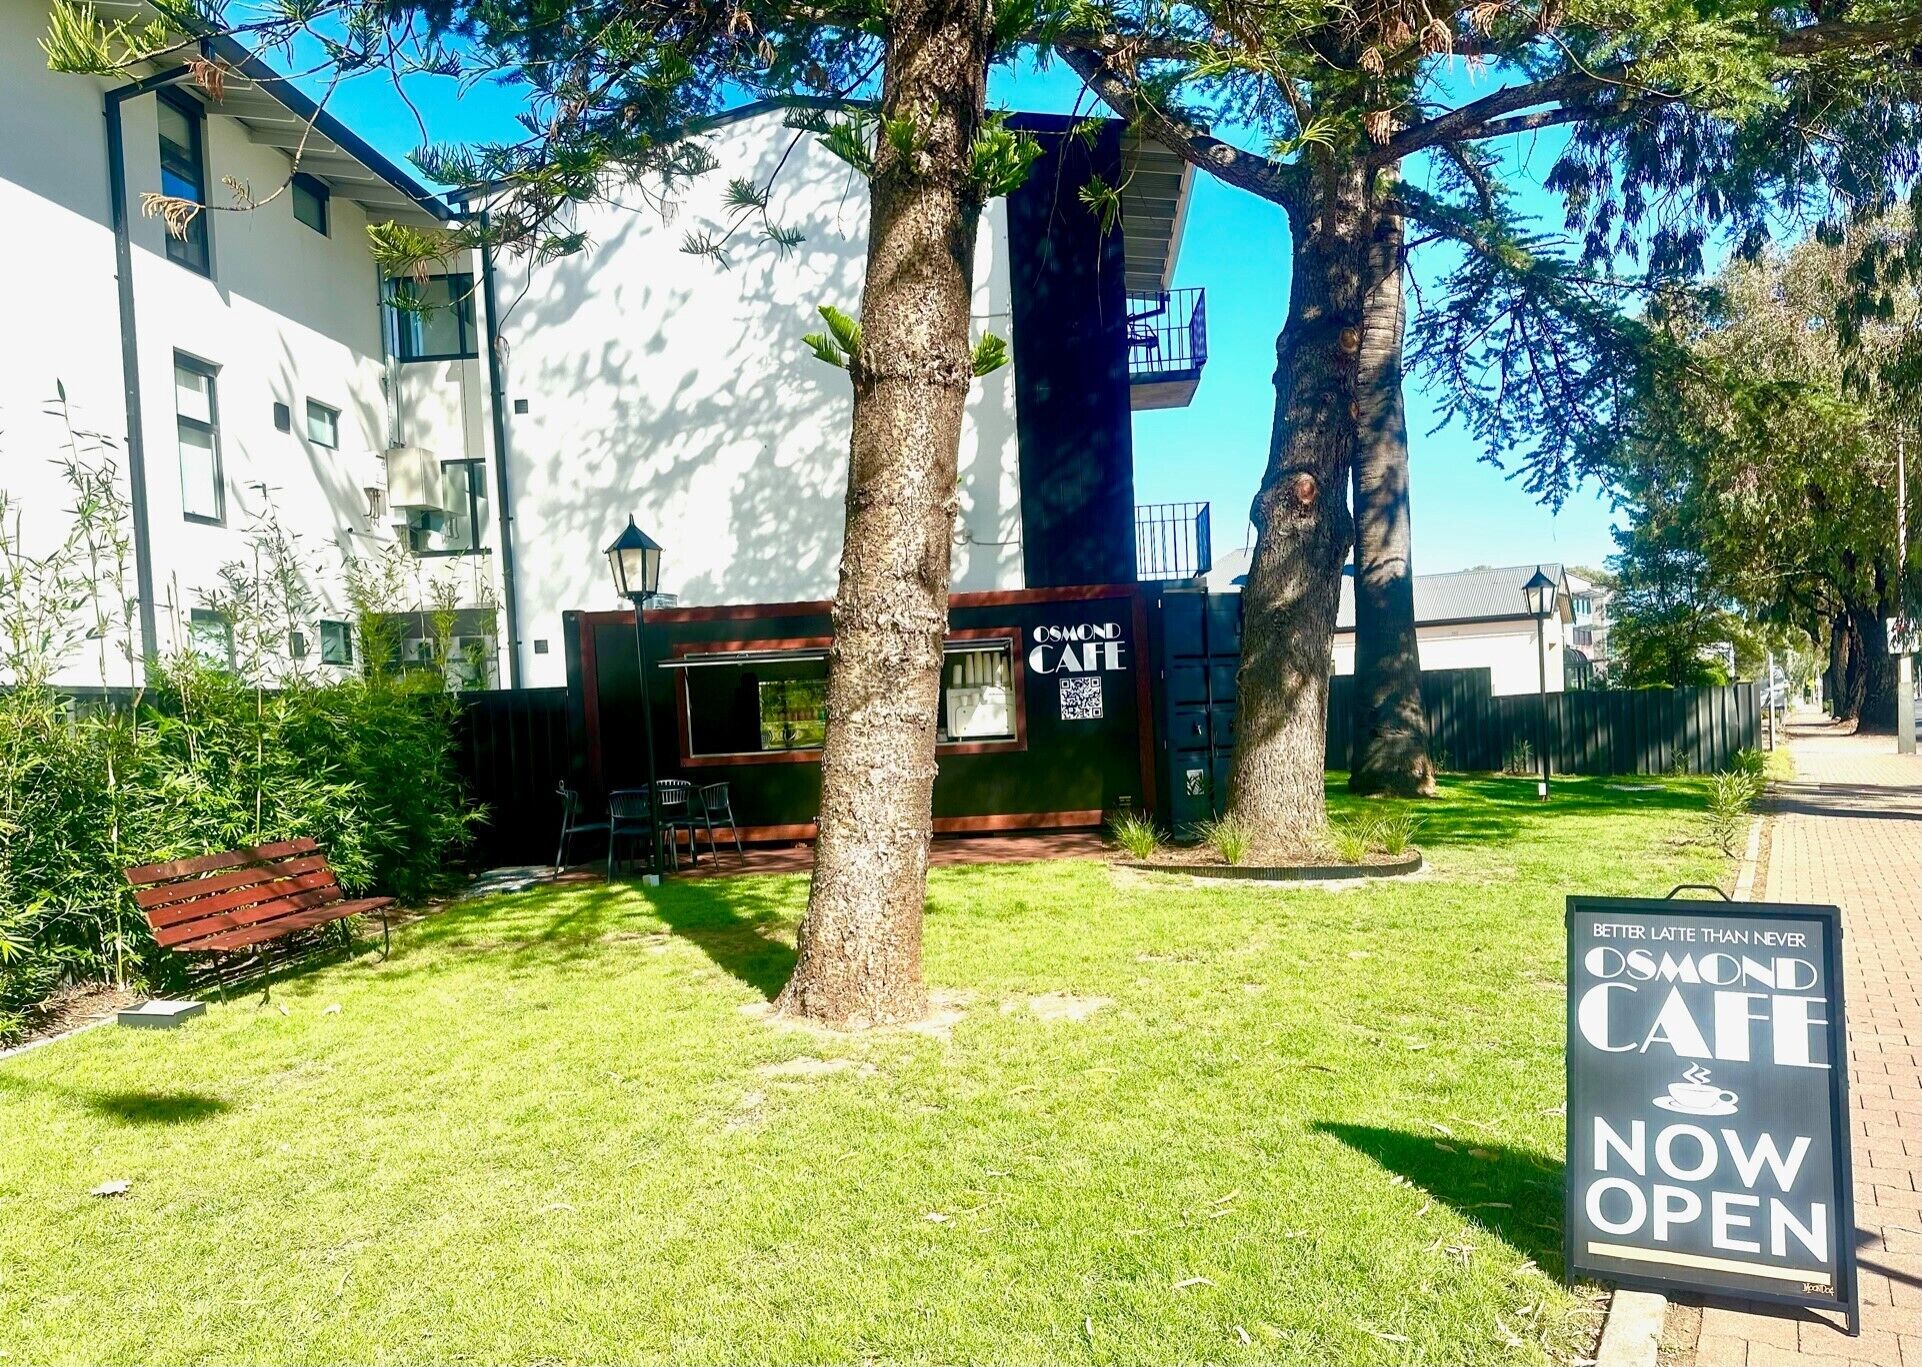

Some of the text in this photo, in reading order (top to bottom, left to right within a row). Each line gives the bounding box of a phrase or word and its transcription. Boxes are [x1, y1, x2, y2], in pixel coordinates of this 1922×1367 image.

[1033, 622, 1121, 643] OSMOND
[1028, 640, 1127, 674] CAFE
[1593, 923, 1807, 948] BETTER LATTE THAN NEVER
[1584, 946, 1818, 991] OSMOND
[1578, 981, 1832, 1069] CAFE
[1594, 1115, 1812, 1194] NOW
[1585, 1176, 1829, 1263] OPEN
